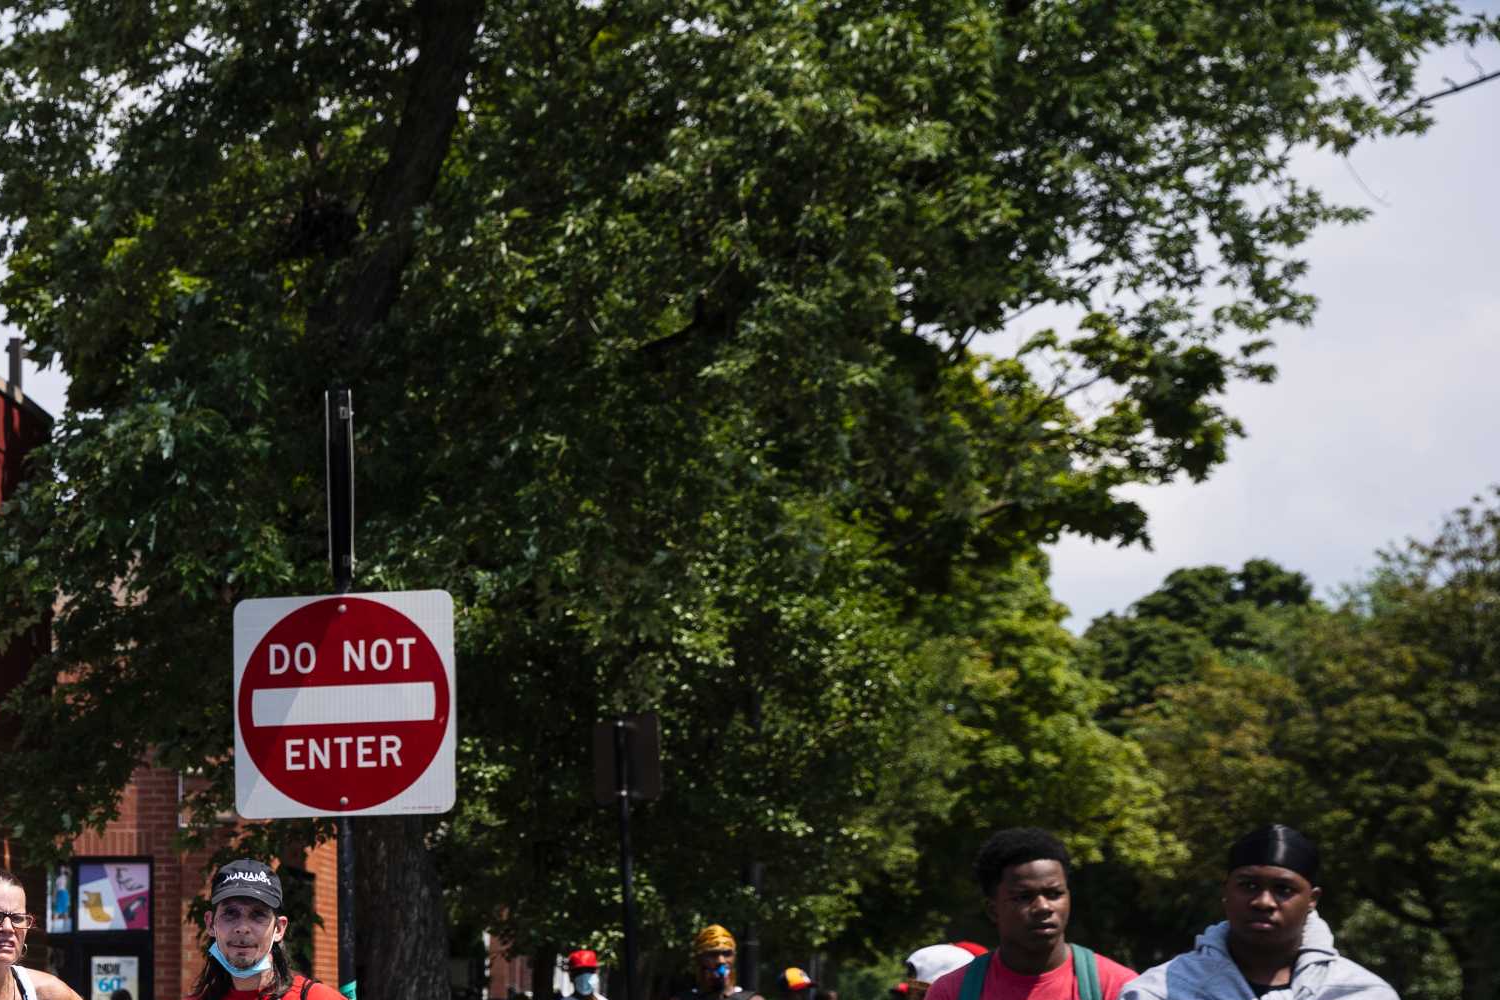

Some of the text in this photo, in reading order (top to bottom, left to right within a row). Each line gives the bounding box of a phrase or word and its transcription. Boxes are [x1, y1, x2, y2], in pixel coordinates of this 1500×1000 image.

[268, 637, 417, 676] DO NOT
[284, 734, 403, 772] ENTER
